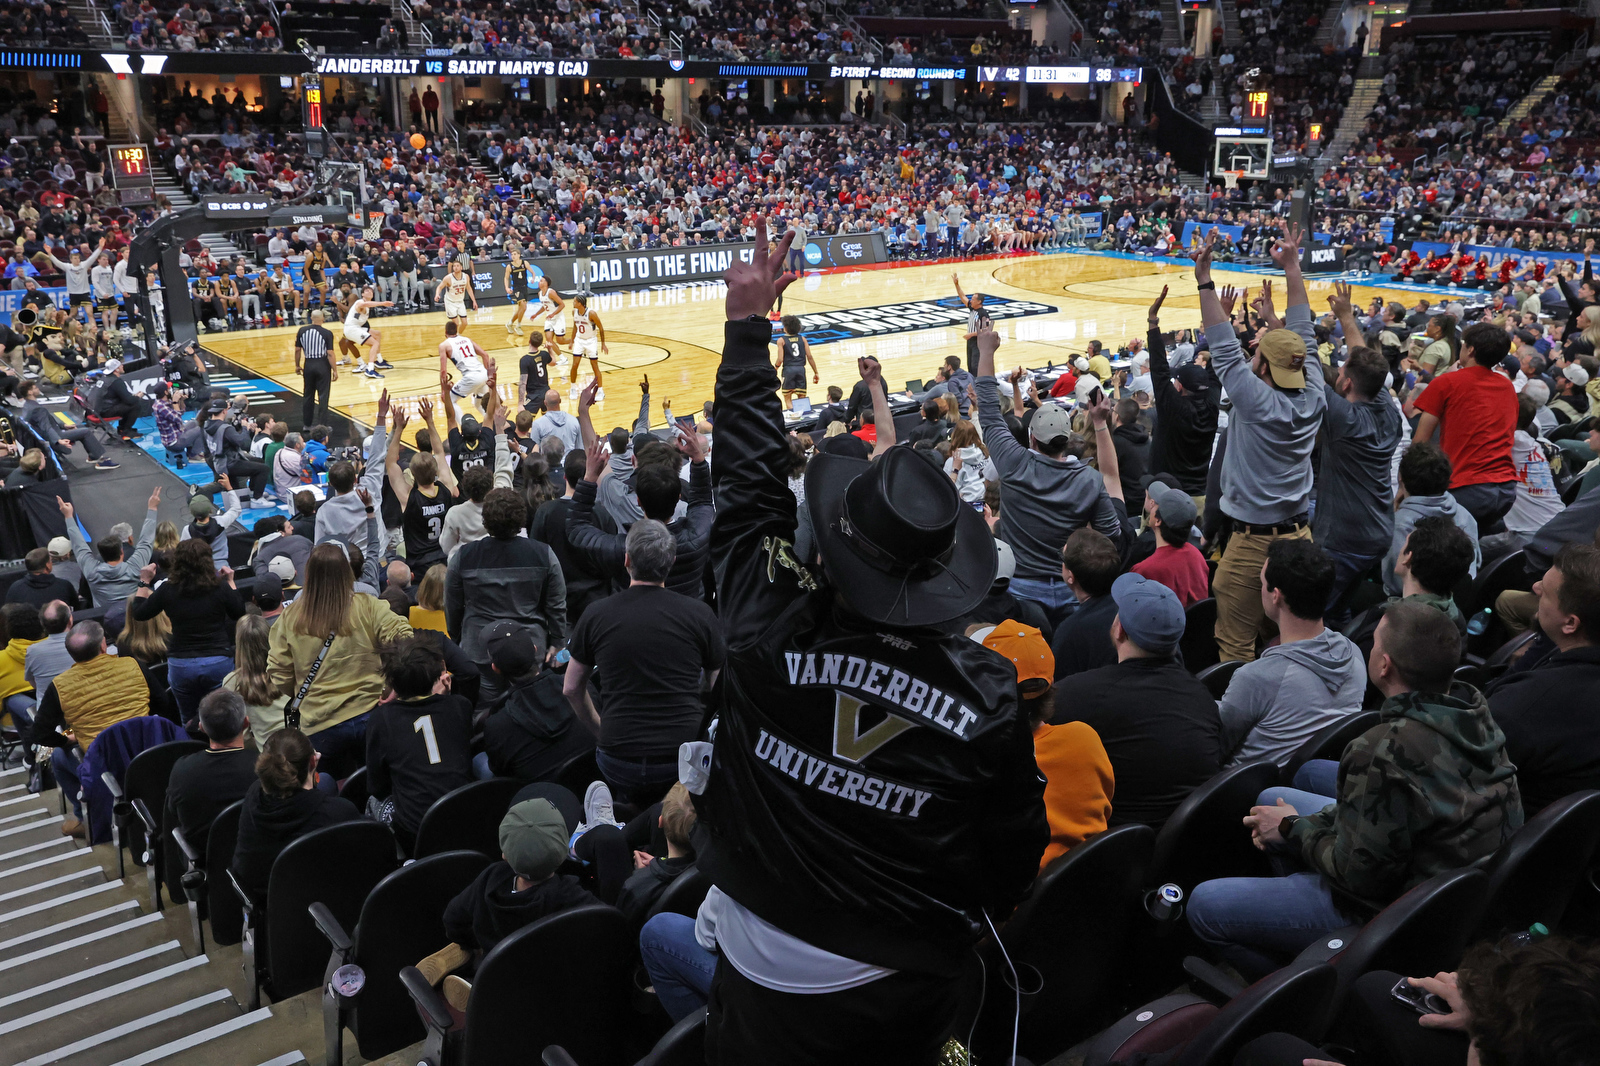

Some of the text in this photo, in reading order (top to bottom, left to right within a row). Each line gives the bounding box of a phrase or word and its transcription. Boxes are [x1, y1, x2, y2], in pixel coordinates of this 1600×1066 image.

[425, 61, 443, 73] VS
[448, 60, 497, 74] SAINT
[499, 60, 555, 75] MARY'S
[558, 61, 589, 76] (CA)
[841, 66, 872, 78] FIRST
[880, 67, 916, 78] SECOND
[916, 68, 955, 79] ROUNDS
[1005, 67, 1021, 81] 42
[1032, 69, 1058, 80] 11:31
[1248, 92, 1268, 102] 11:30
[310, 103, 322, 127] 17
[1251, 101, 1266, 117] 17
[118, 148, 143, 160] 11:30
[126, 160, 141, 174] 17
[292, 214, 324, 225] SPALDING
[841, 242, 863, 251] Great
[806, 252, 822, 260] NCAA
[844, 250, 862, 260] Clips
[1310, 248, 1336, 264] NCAA
[626, 257, 650, 279] TO
[653, 254, 687, 277] THE
[471, 272, 493, 281] reat
[454, 287, 465, 295] 33
[473, 280, 493, 292] lips
[799, 301, 945, 331] MARCH
[840, 301, 1050, 335] MADNSS
[578, 325, 586, 334] 0
[459, 345, 474, 358] 11
[791, 342, 800, 357] 3
[536, 361, 545, 378] 5
[421, 503, 446, 516] TANNER
[427, 517, 442, 540] 3
[323, 633, 335, 648] GO
[296, 656, 323, 700] GO VANDY
[784, 651, 978, 737] VANDERBILT
[833, 689, 921, 764] V
[413, 714, 442, 765] 1
[754, 730, 932, 818] UNIVERSITY
